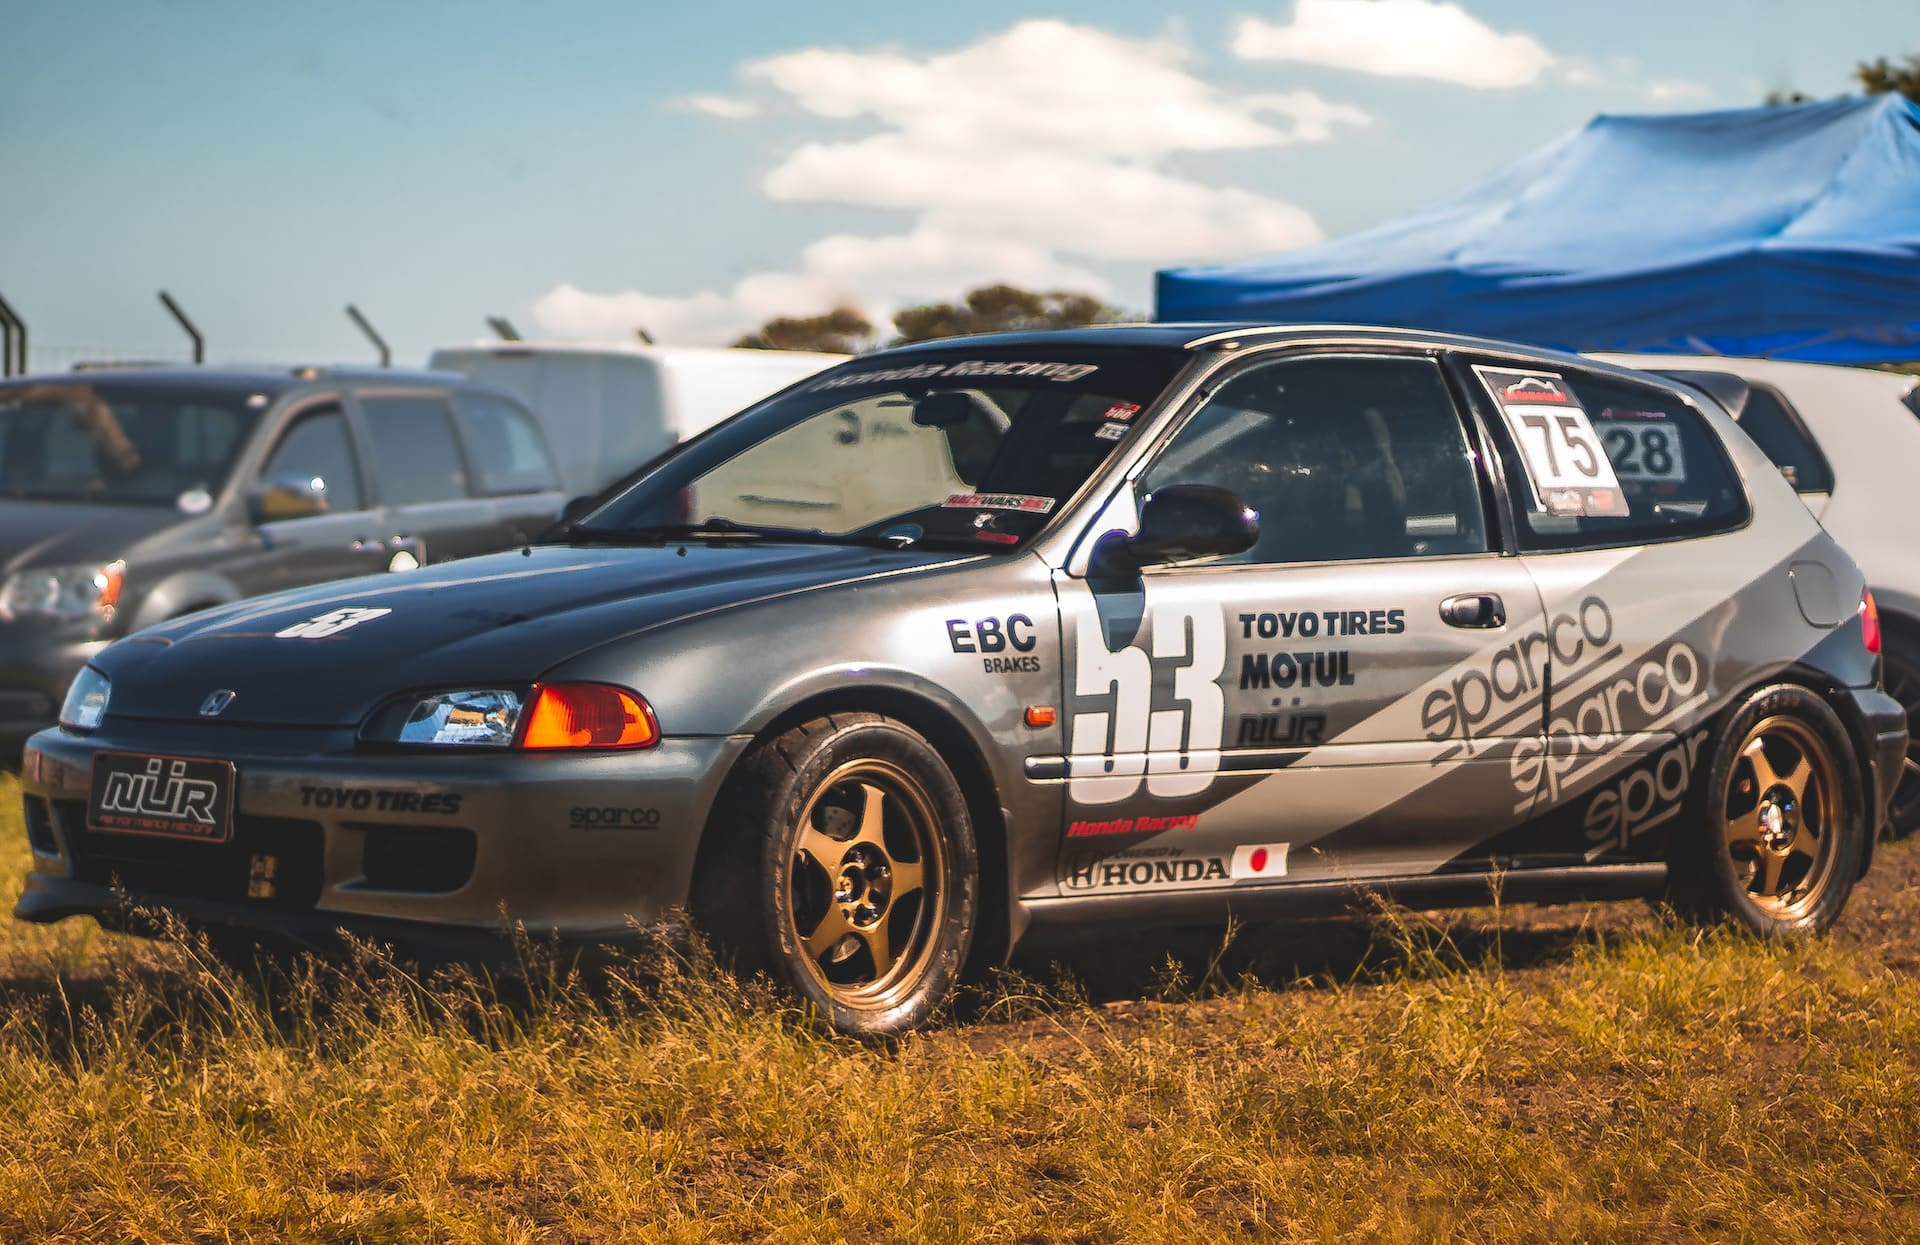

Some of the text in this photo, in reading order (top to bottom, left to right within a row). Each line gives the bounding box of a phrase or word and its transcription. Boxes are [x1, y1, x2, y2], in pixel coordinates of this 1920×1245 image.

[940, 360, 1099, 382] Racing
[1520, 415, 1600, 478] 75
[1604, 426, 1674, 475] 28
[946, 613, 1037, 653] EBC
[1239, 609, 1406, 639] TOYO TIRES
[983, 656, 1041, 674] BRAKES
[1239, 651, 1355, 690] MOTUL
[1421, 596, 1612, 755] sparco
[1069, 601, 1227, 805] 53
[1510, 642, 1699, 802] sparco
[101, 758, 217, 824] NÜR
[302, 786, 464, 815] TOYO TIRES
[1584, 729, 1709, 849] spar
[569, 806, 661, 832] sparco
[1067, 814, 1200, 838] Honda Racing
[1102, 857, 1231, 887] HONDA
